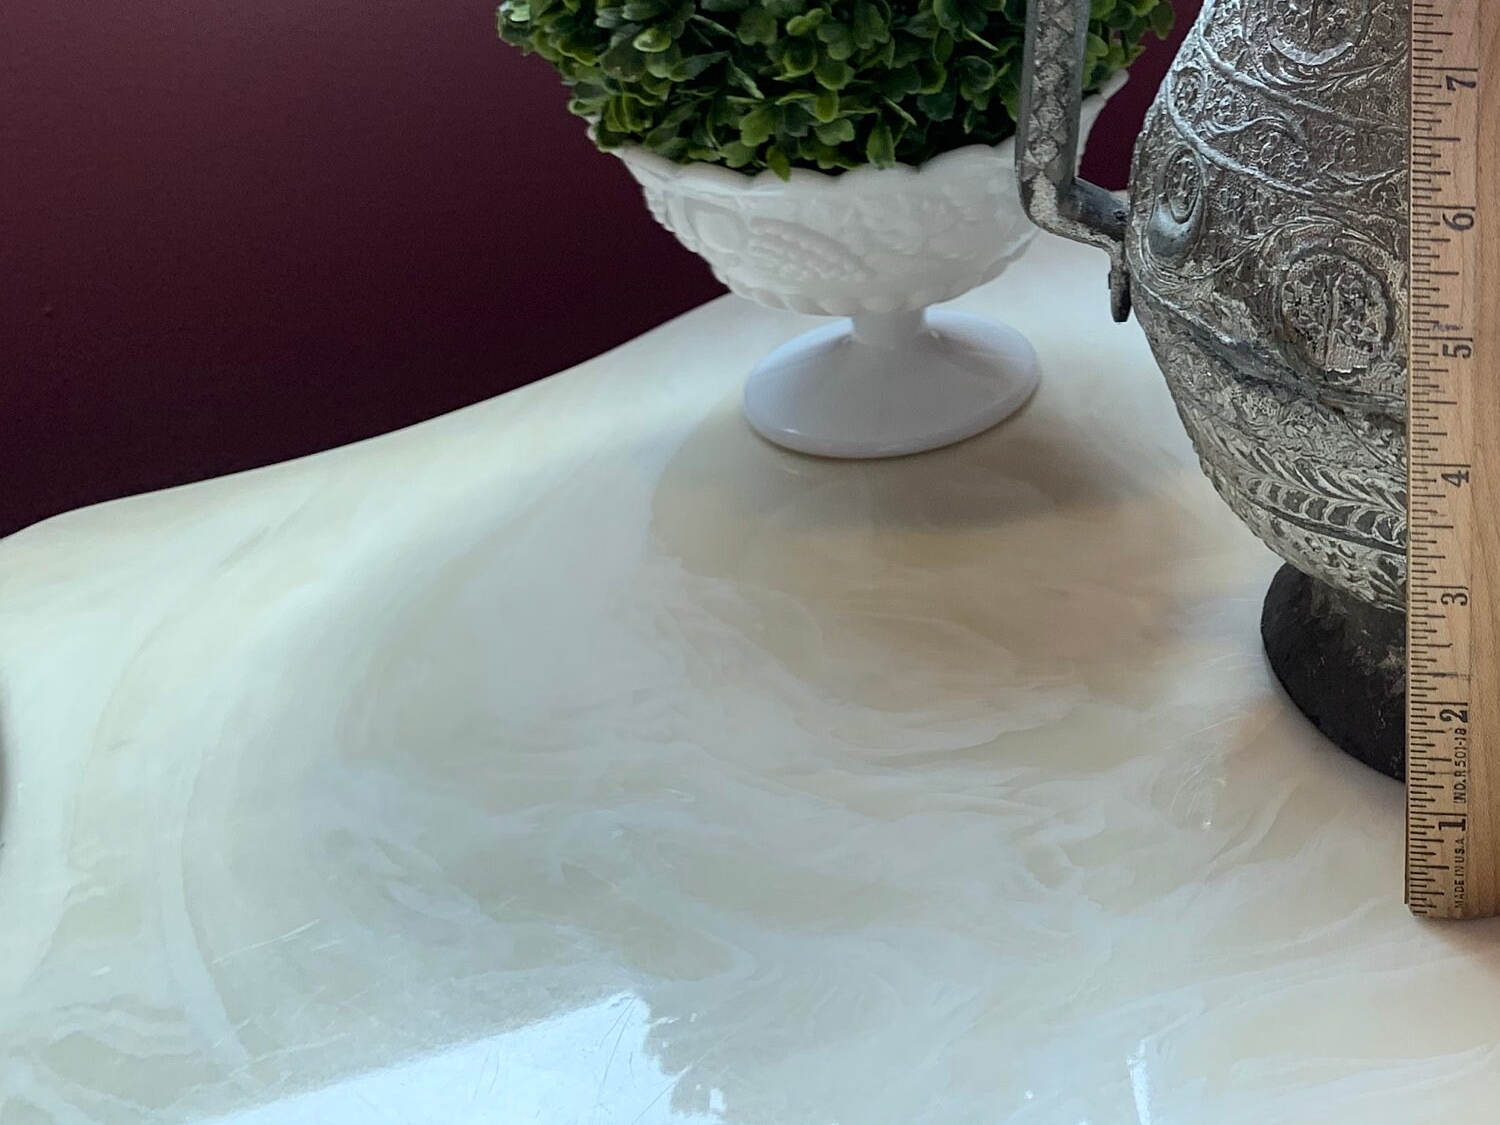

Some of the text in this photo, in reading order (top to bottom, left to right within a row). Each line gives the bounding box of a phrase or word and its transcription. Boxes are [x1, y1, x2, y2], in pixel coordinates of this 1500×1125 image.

[1446, 74, 1477, 92] 7
[1442, 212, 1475, 232] 6
[1442, 343, 1472, 360] 5
[1440, 469, 1470, 489] 4
[1440, 591, 1468, 607] 3
[1439, 708, 1469, 724] 2
[1438, 818, 1466, 832] 1
[1454, 865, 1465, 877] IN
[1454, 879, 1466, 909] MADE
